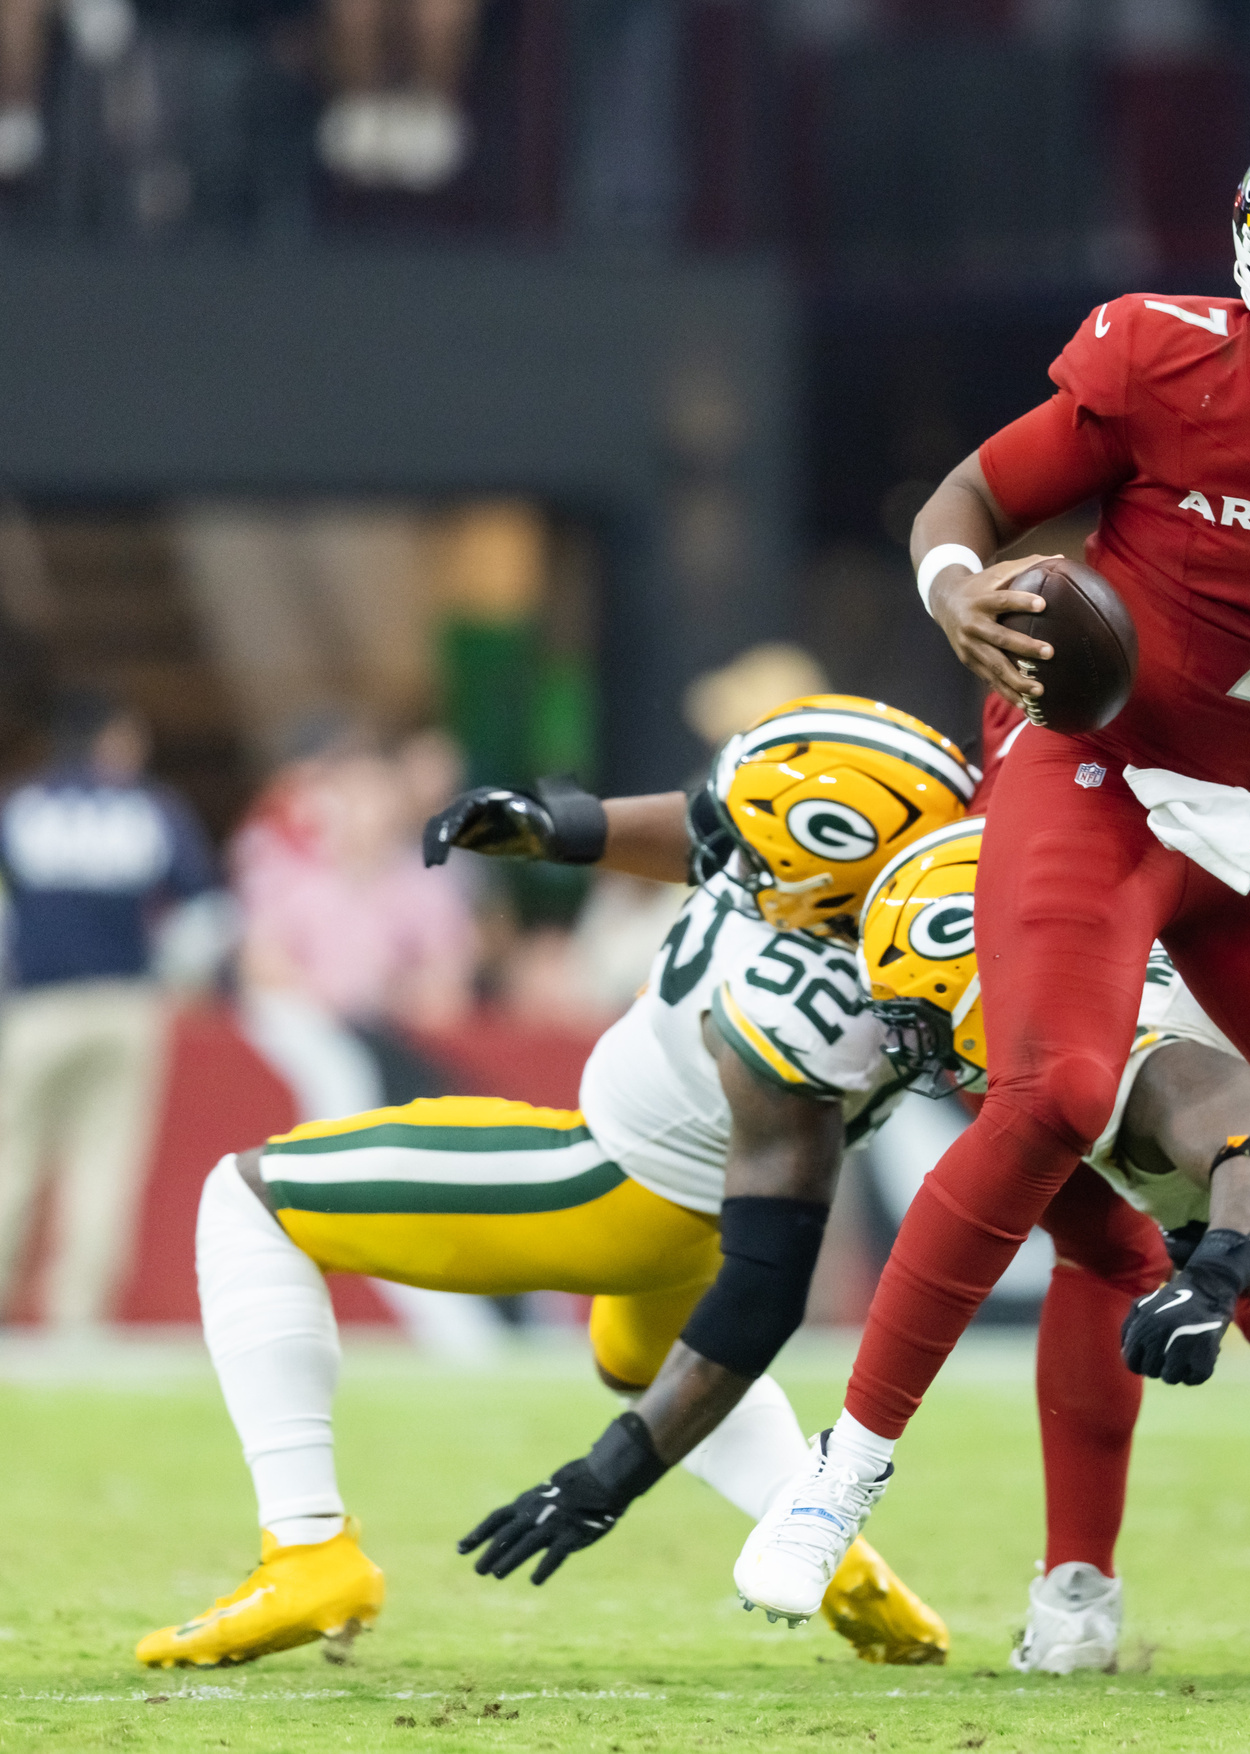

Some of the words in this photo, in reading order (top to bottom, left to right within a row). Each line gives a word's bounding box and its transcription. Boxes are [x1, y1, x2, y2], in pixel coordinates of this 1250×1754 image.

[1144, 300, 1228, 337] 7
[786, 798, 878, 862] G
[745, 932, 867, 1046] 52
